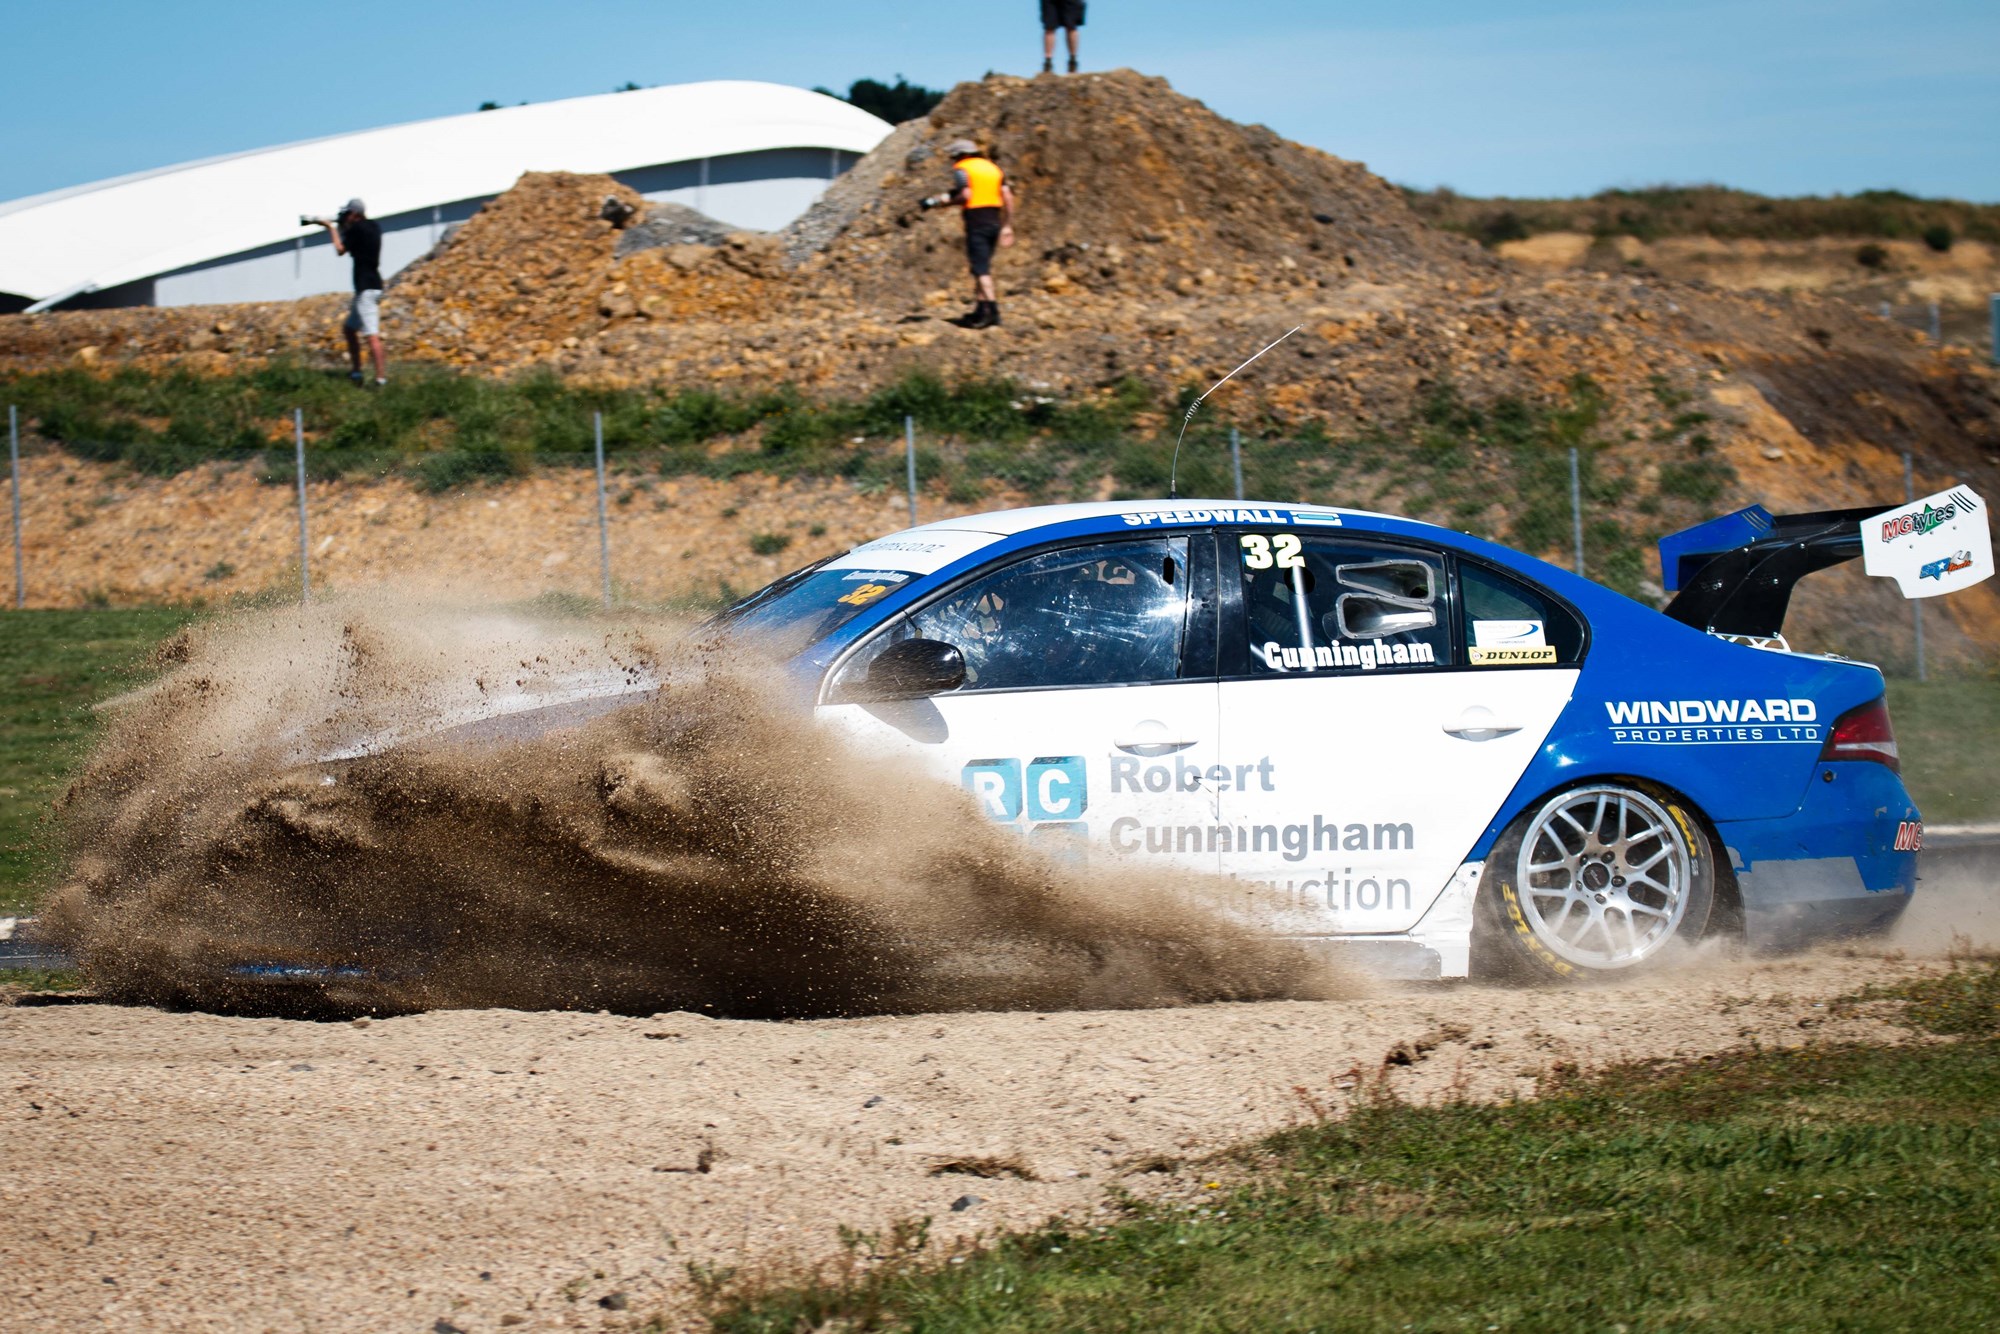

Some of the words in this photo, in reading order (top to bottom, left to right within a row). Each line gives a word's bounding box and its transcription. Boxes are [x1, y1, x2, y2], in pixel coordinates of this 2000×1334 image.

[1121, 509, 1288, 526] SPEEDWALL
[1240, 533, 1306, 569] 32
[837, 583, 887, 606] 32
[1263, 638, 1436, 670] Cunningham
[1485, 651, 1553, 660] DUNLOP
[1604, 699, 1817, 724] WINDWARD
[1614, 728, 1764, 741] PROPERTIES
[1777, 728, 1818, 740] LTD
[1110, 755, 1276, 793] Robert
[1109, 814, 1415, 862] Cunningham
